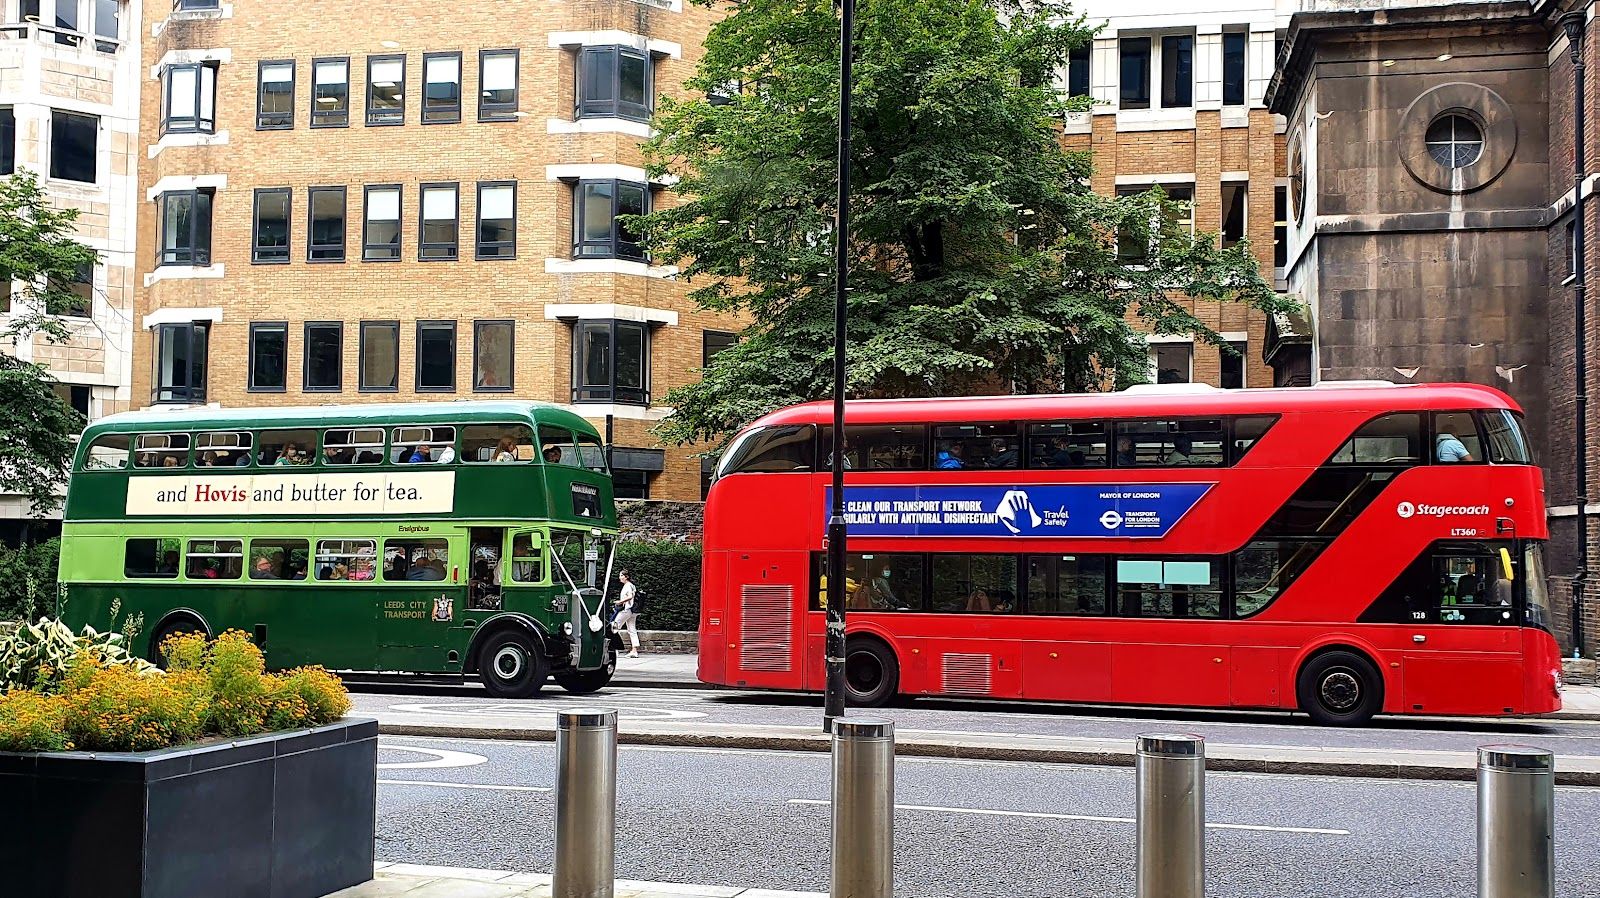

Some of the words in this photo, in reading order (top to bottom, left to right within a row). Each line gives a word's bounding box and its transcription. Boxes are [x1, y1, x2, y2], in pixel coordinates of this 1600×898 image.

[157, 486, 187, 502] and
[194, 485, 247, 502] Hovis
[253, 484, 284, 502] and
[291, 483, 347, 502] butter
[353, 482, 380, 501] for
[387, 482, 423, 500] tea.
[848, 501, 872, 512] CLEAN
[874, 501, 891, 512] OUR
[893, 501, 940, 512] TRANSPORT
[942, 501, 982, 512] NETWORK
[1043, 505, 1069, 519] Travel
[1417, 504, 1489, 517] Stagecoach
[843, 513, 877, 524] GULARLY
[879, 513, 899, 524] WITH
[901, 513, 942, 524] ANTIVIRAL
[944, 513, 999, 524] DISINFECTANT
[1043, 518, 1067, 527] Safely
[384, 601, 405, 609] LEEDS
[410, 601, 427, 609] CITY
[384, 611, 427, 619] TRANSPORT
